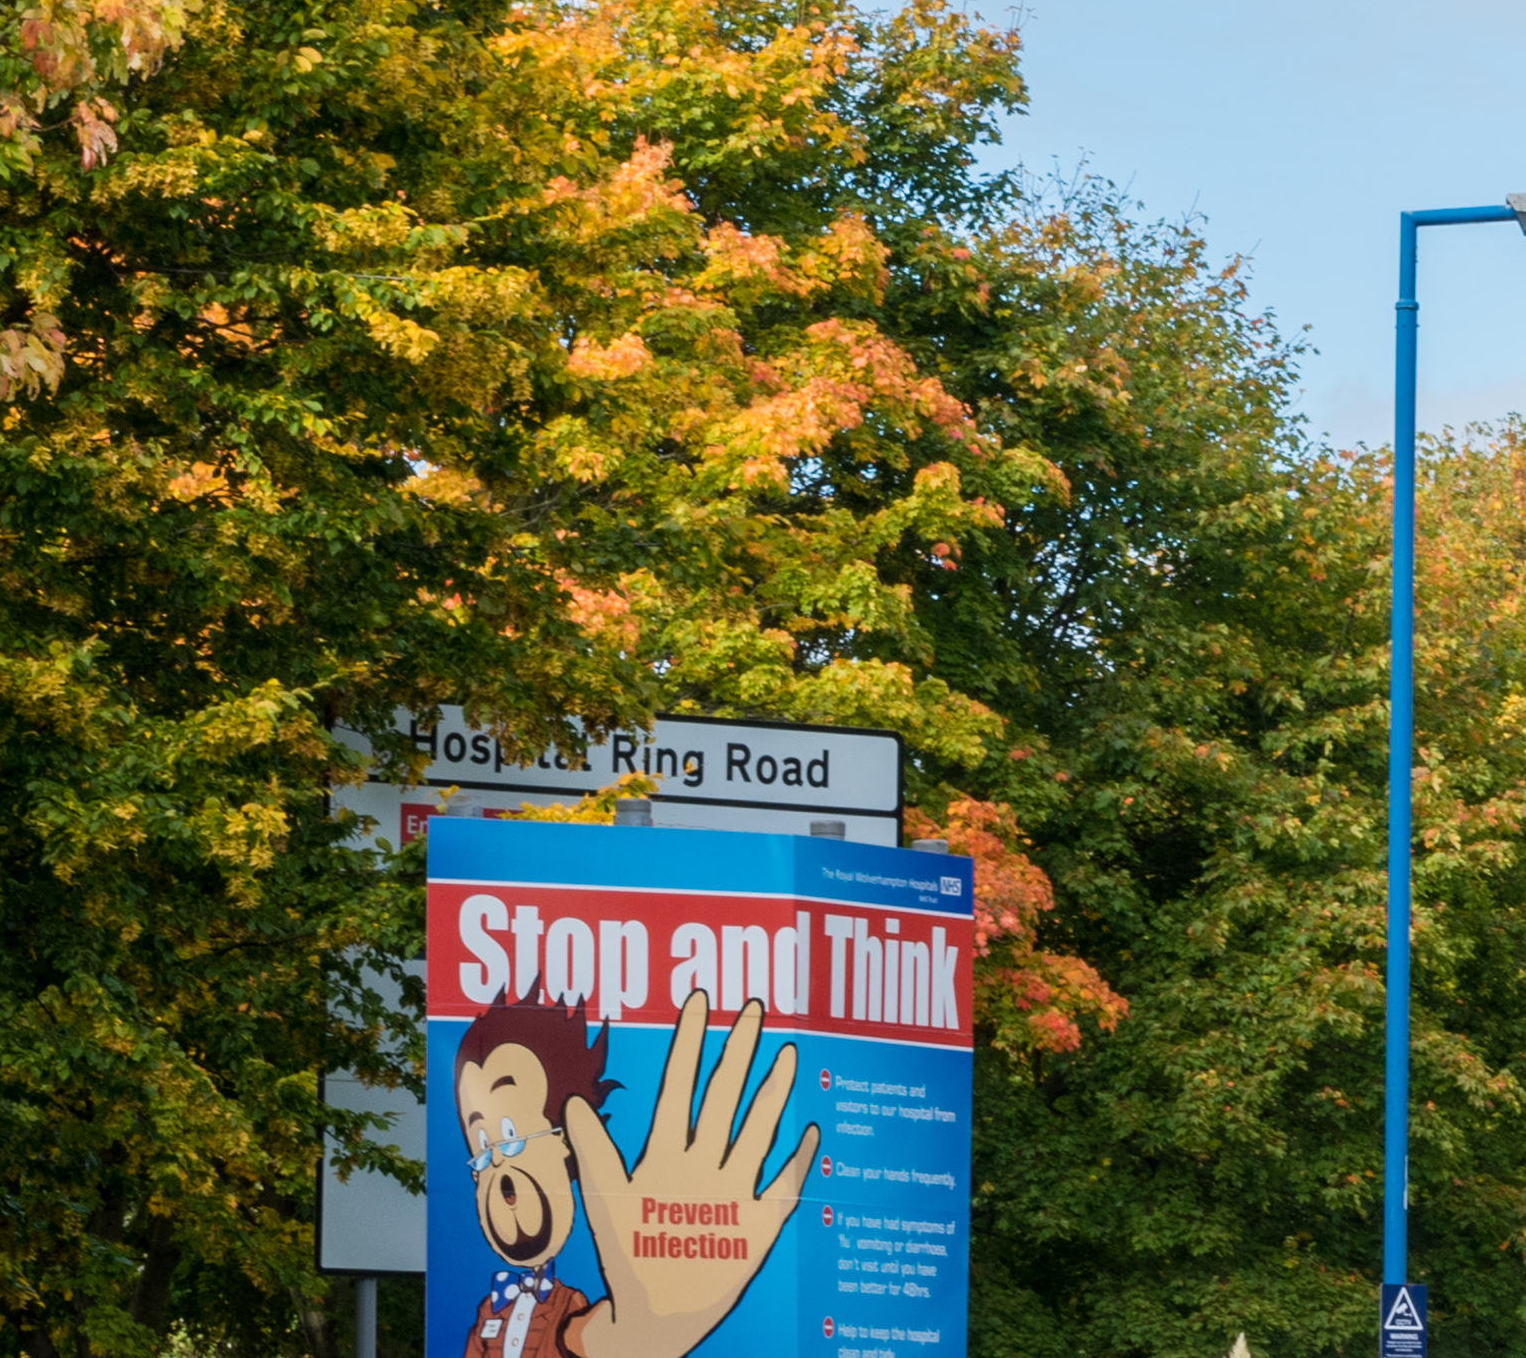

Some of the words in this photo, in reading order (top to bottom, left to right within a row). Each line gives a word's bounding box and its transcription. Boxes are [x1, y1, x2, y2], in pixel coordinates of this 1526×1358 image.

[410, 720, 593, 774] Hospal
[612, 734, 704, 787] Ring
[727, 743, 830, 788] Road
[941, 877, 961, 895] NHS
[458, 894, 649, 1020] Stop
[670, 911, 811, 1016] and
[824, 913, 959, 1030] Think
[835, 1074, 869, 1093] Protect
[871, 1083, 907, 1097] patients
[909, 1084, 926, 1098] and
[870, 1104, 880, 1115] to
[881, 1106, 896, 1116] our
[898, 1105, 933, 1122] hospital
[934, 1107, 956, 1122] from
[836, 1161, 861, 1178] Clean
[862, 1168, 882, 1181] your
[883, 1167, 910, 1182] hands
[641, 1196, 740, 1226] Prevent
[845, 1216, 860, 1229] you
[862, 1215, 882, 1229] have
[884, 1216, 900, 1231] had
[901, 1220, 946, 1235] symptoms
[946, 1220, 956, 1235] of
[633, 1230, 748, 1260] Infection
[894, 1242, 904, 1252] or
[900, 1263, 916, 1277] you
[917, 1261, 937, 1277] have
[837, 1278, 858, 1292] been
[860, 1278, 887, 1295] better
[837, 1323, 857, 1341] Help
[858, 1326, 869, 1339] to
[870, 1326, 890, 1342] keep
[891, 1327, 906, 1341] the
[907, 1327, 940, 1346] hospital
